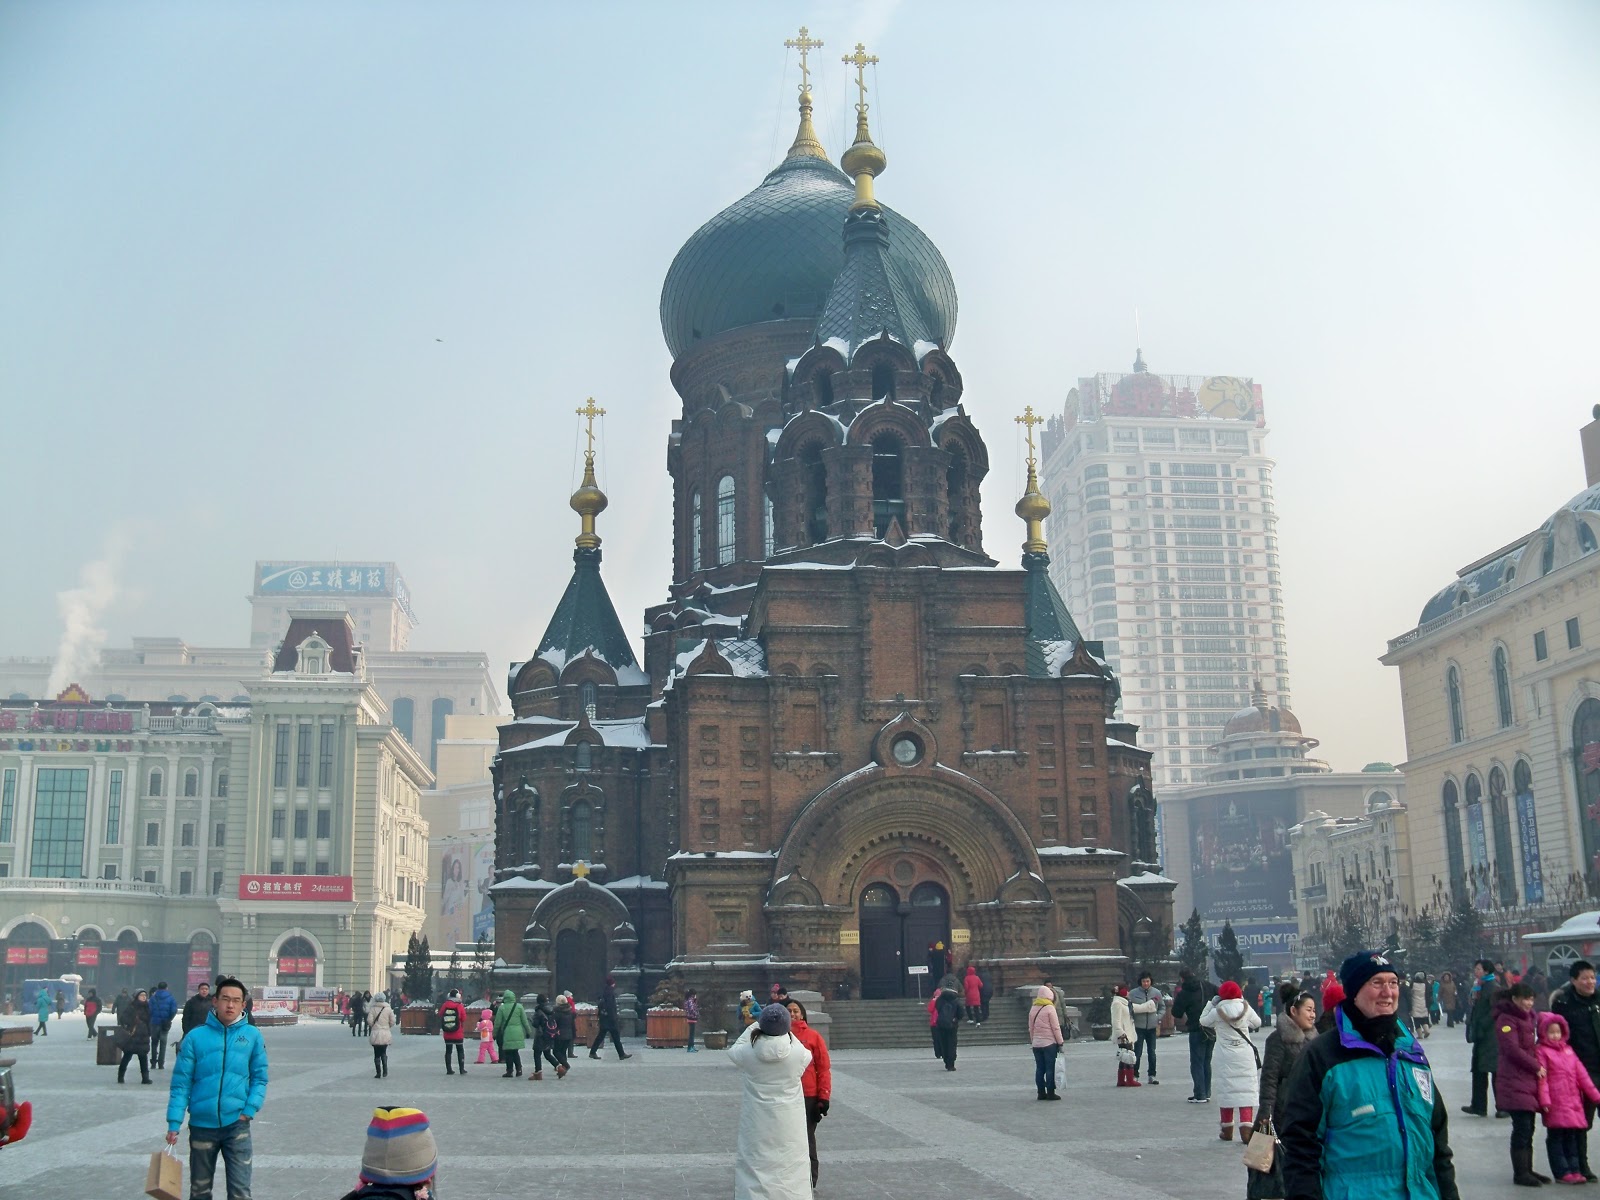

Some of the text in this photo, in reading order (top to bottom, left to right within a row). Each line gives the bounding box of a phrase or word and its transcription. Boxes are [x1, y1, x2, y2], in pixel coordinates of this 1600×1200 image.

[309, 568, 382, 590] 三精制药
[263, 882, 302, 891] 招商银行
[1234, 933, 1282, 946] ENTURY
